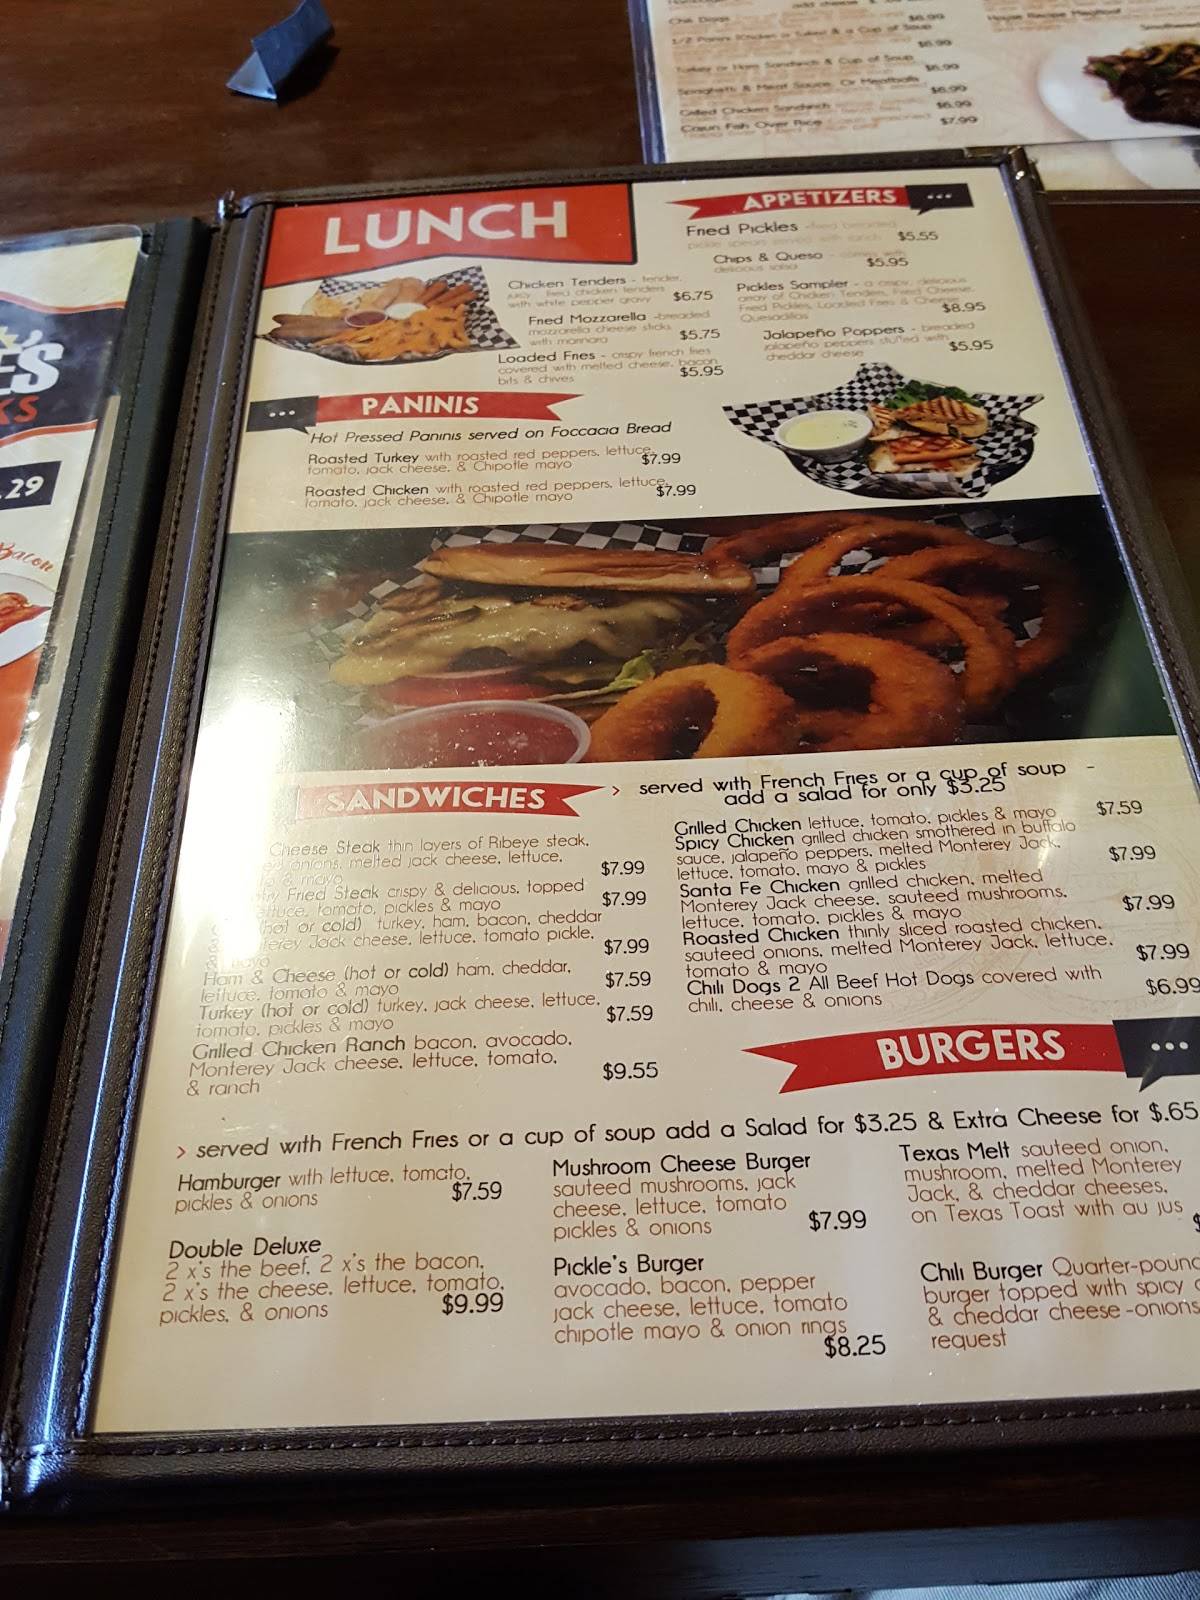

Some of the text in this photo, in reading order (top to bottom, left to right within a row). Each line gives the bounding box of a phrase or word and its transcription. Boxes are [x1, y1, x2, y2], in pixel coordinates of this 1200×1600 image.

[743, 189, 896, 211] APPETIZERS
[324, 201, 567, 255] LUNCH
[687, 225, 730, 236] Fried
[739, 222, 798, 235] Pickles
[898, 231, 938, 241] $5.55
[714, 254, 752, 265] Chips
[759, 253, 768, 262] &
[776, 250, 823, 261] Queso
[867, 257, 908, 267] $5.95
[508, 277, 626, 289] Chicken Tenders
[737, 279, 848, 292] Pickles Sampler
[673, 291, 713, 302] $6.75
[942, 302, 986, 314] $8.95
[529, 312, 646, 325] Fried Mozzarella
[680, 329, 720, 340] $5.75
[843, 326, 904, 338] Poppers
[950, 340, 993, 351] $5.95
[499, 351, 595, 363] Loaded Fries
[524, 375, 532, 384] &
[680, 366, 723, 377] $5.95
[362, 396, 480, 415] PANINIS
[310, 432, 338, 444] Hot
[345, 431, 404, 443] Pressed
[409, 429, 462, 442] Paninis
[468, 428, 519, 440] served
[525, 429, 544, 438] on
[627, 422, 671, 434] Bread
[308, 449, 535, 464] Roasted Turkey with roasted red
[642, 453, 681, 465] $7.99
[305, 484, 428, 497] Roasted Chicken
[656, 485, 696, 497] $7.99
[640, 762, 1066, 795] served with French Fries or a cup of soup
[326, 785, 547, 812] SANDWICHES
[724, 777, 1006, 806] add a salad for only $3.25
[1096, 800, 1142, 816] $7.59
[674, 818, 802, 837] Grilled Chicken
[337, 840, 380, 854] Steak
[675, 834, 795, 852] Spicy Chicken
[1109, 846, 1156, 862] $7.99
[601, 861, 645, 876] $7.99
[680, 879, 840, 898] Santa Fe Chicken
[385, 898, 500, 914] pickles & mayo
[602, 891, 647, 907] $7.99
[1122, 894, 1176, 912] $7.99
[683, 927, 840, 947] Roasted Chicken
[604, 938, 649, 955] $7.99
[1136, 944, 1190, 962] $7.99
[251, 970, 263, 984] &
[273, 968, 335, 983] Cheese
[605, 971, 651, 988] $7.59
[687, 973, 878, 996] Chili Dogs 2 All Beef
[200, 1005, 253, 1020] Turkey
[607, 1005, 653, 1023] $7.59
[192, 1036, 405, 1059] Grilled Chicken Ranch
[876, 1029, 1066, 1071] BURGERS
[603, 1062, 659, 1080] $9.55
[196, 1101, 1199, 1159] served with French Fries or a cup of soup add a Salad for $3.25 & Extra Cheese for $.65
[900, 1141, 1010, 1163] Texas Melt
[553, 1152, 810, 1177] Mushroom Cheese Burger
[177, 1173, 281, 1193] Hamburger
[451, 1181, 503, 1202] $7.59
[809, 1209, 867, 1232] $7.99
[169, 1236, 322, 1260] Double Deluxe
[554, 1253, 705, 1276] Pickle's Burger
[920, 1259, 1043, 1284] Chili Burger
[442, 1292, 505, 1316] $9.99
[824, 1334, 887, 1358] $8.25
